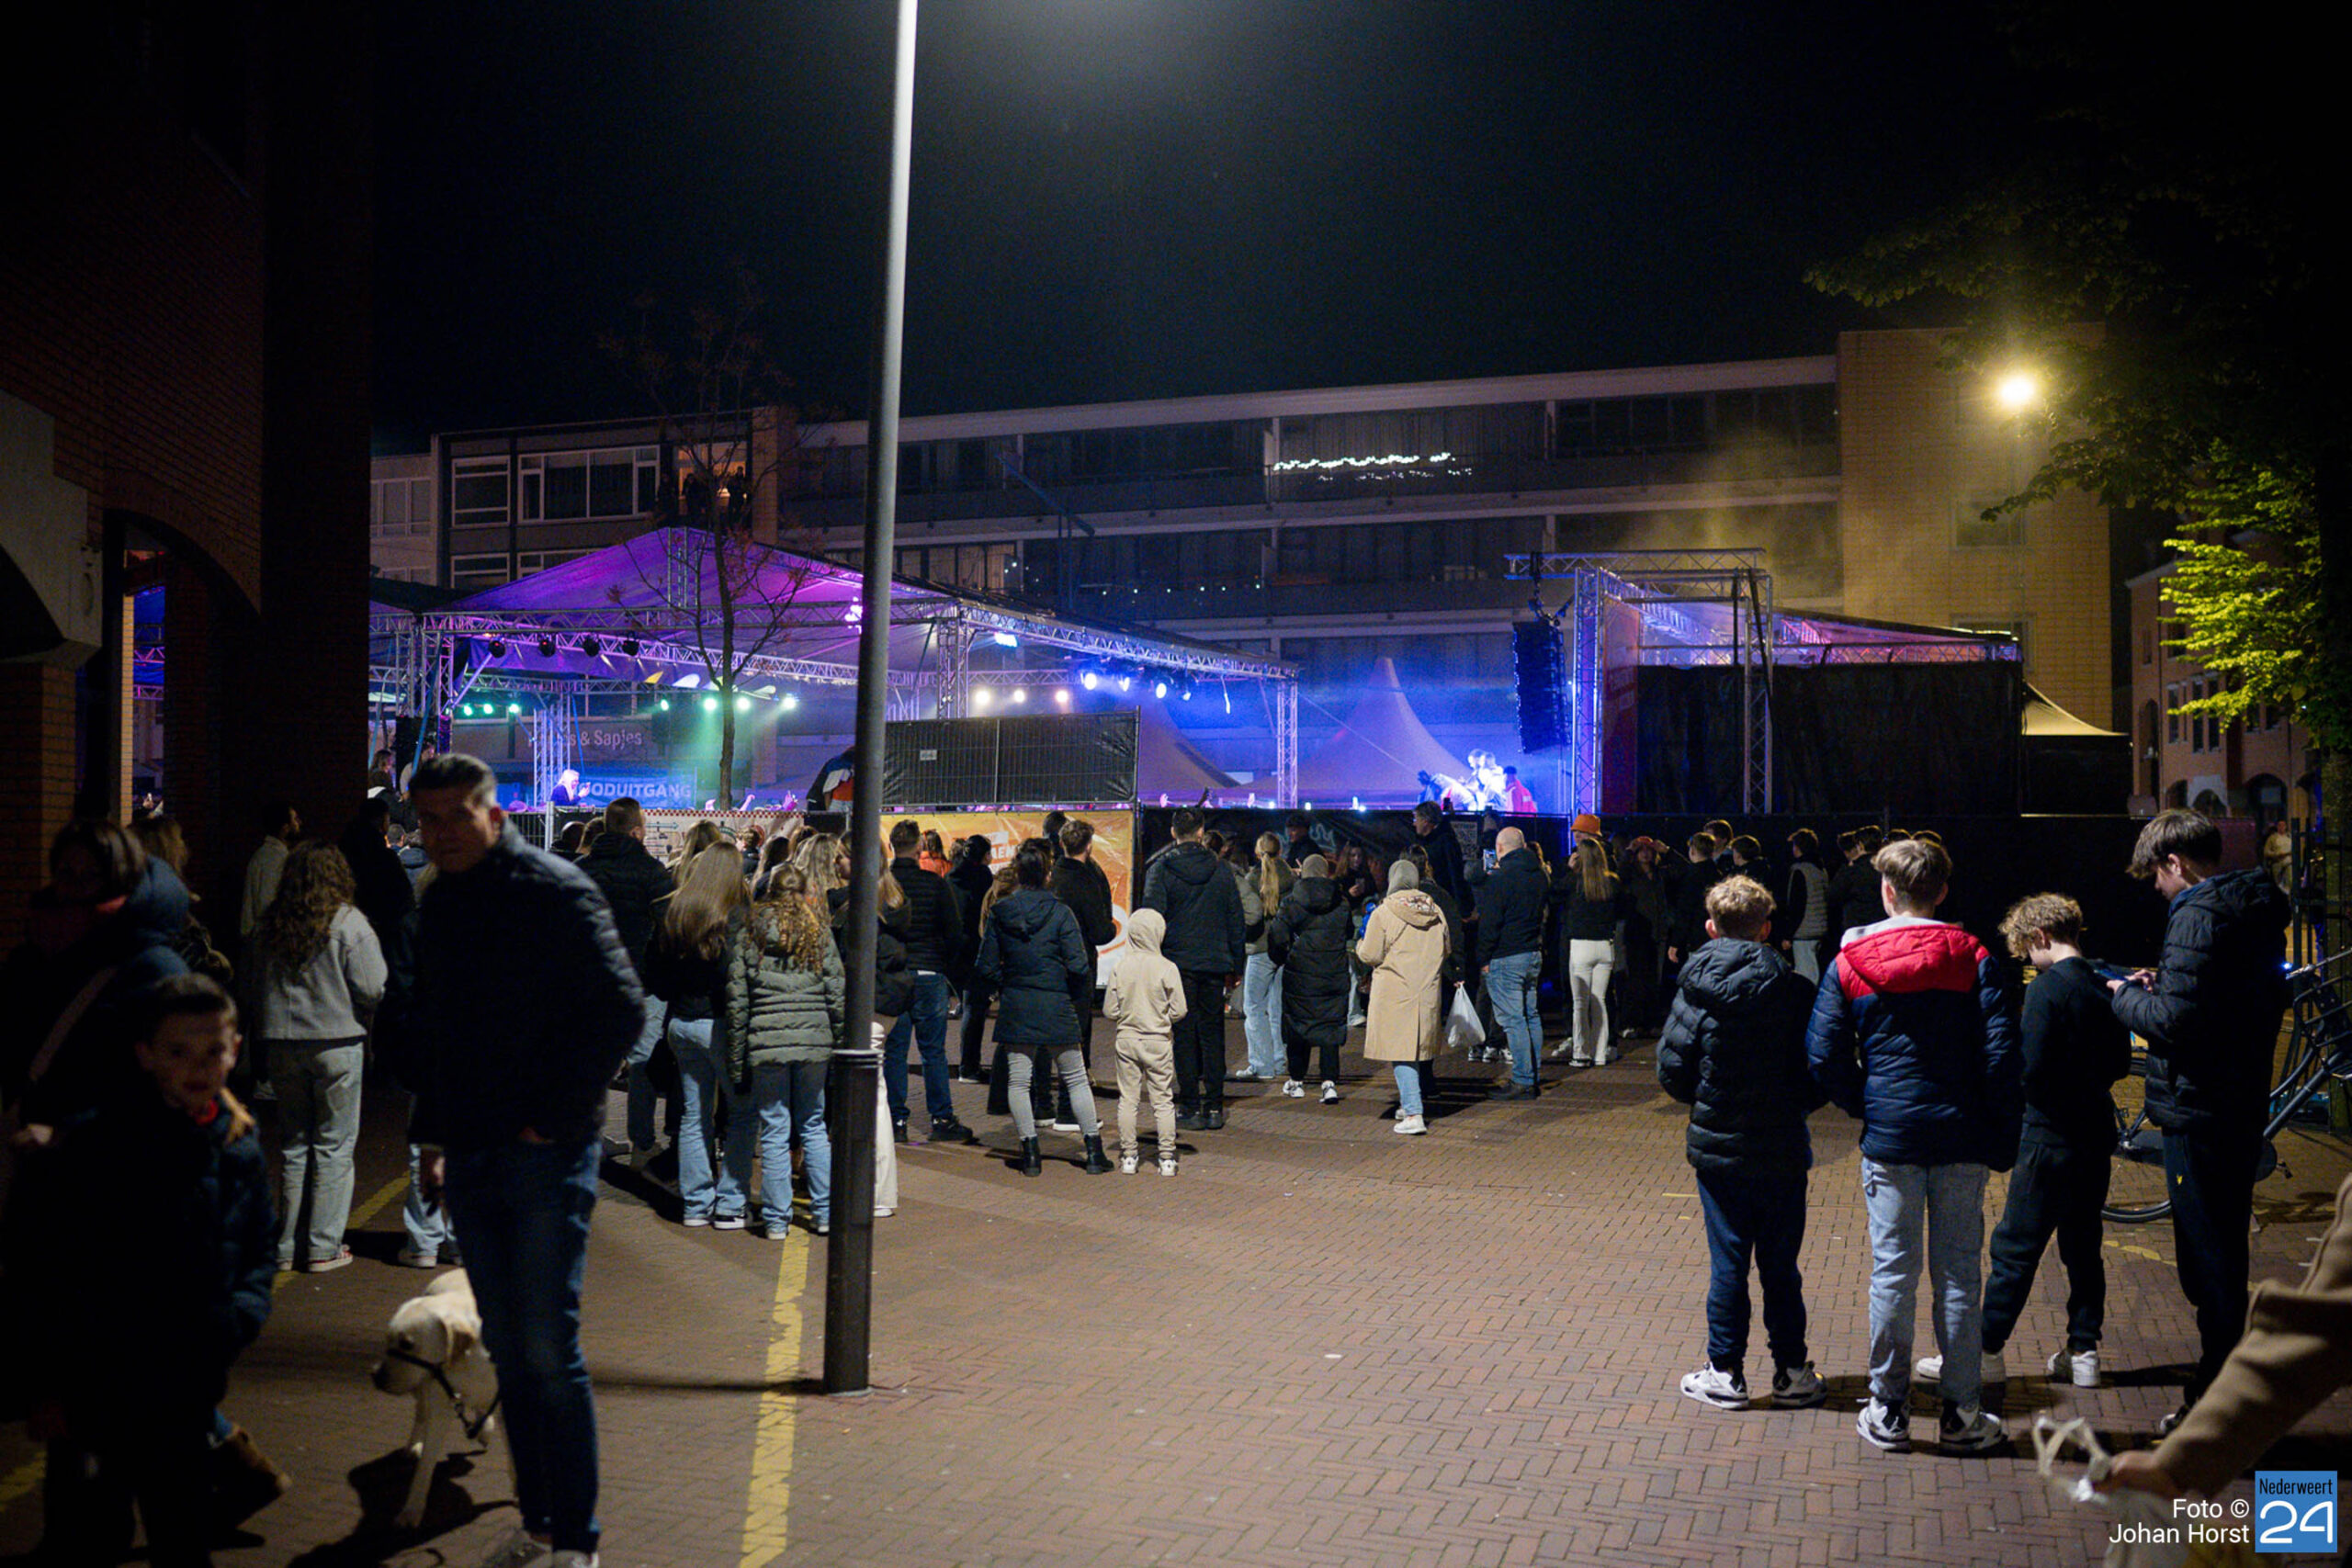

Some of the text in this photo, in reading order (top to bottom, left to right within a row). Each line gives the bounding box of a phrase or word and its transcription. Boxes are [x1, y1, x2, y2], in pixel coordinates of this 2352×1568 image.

[581, 731, 591, 747] &
[594, 729, 642, 750] Sapjes
[573, 782, 692, 798] ODUITGANG
